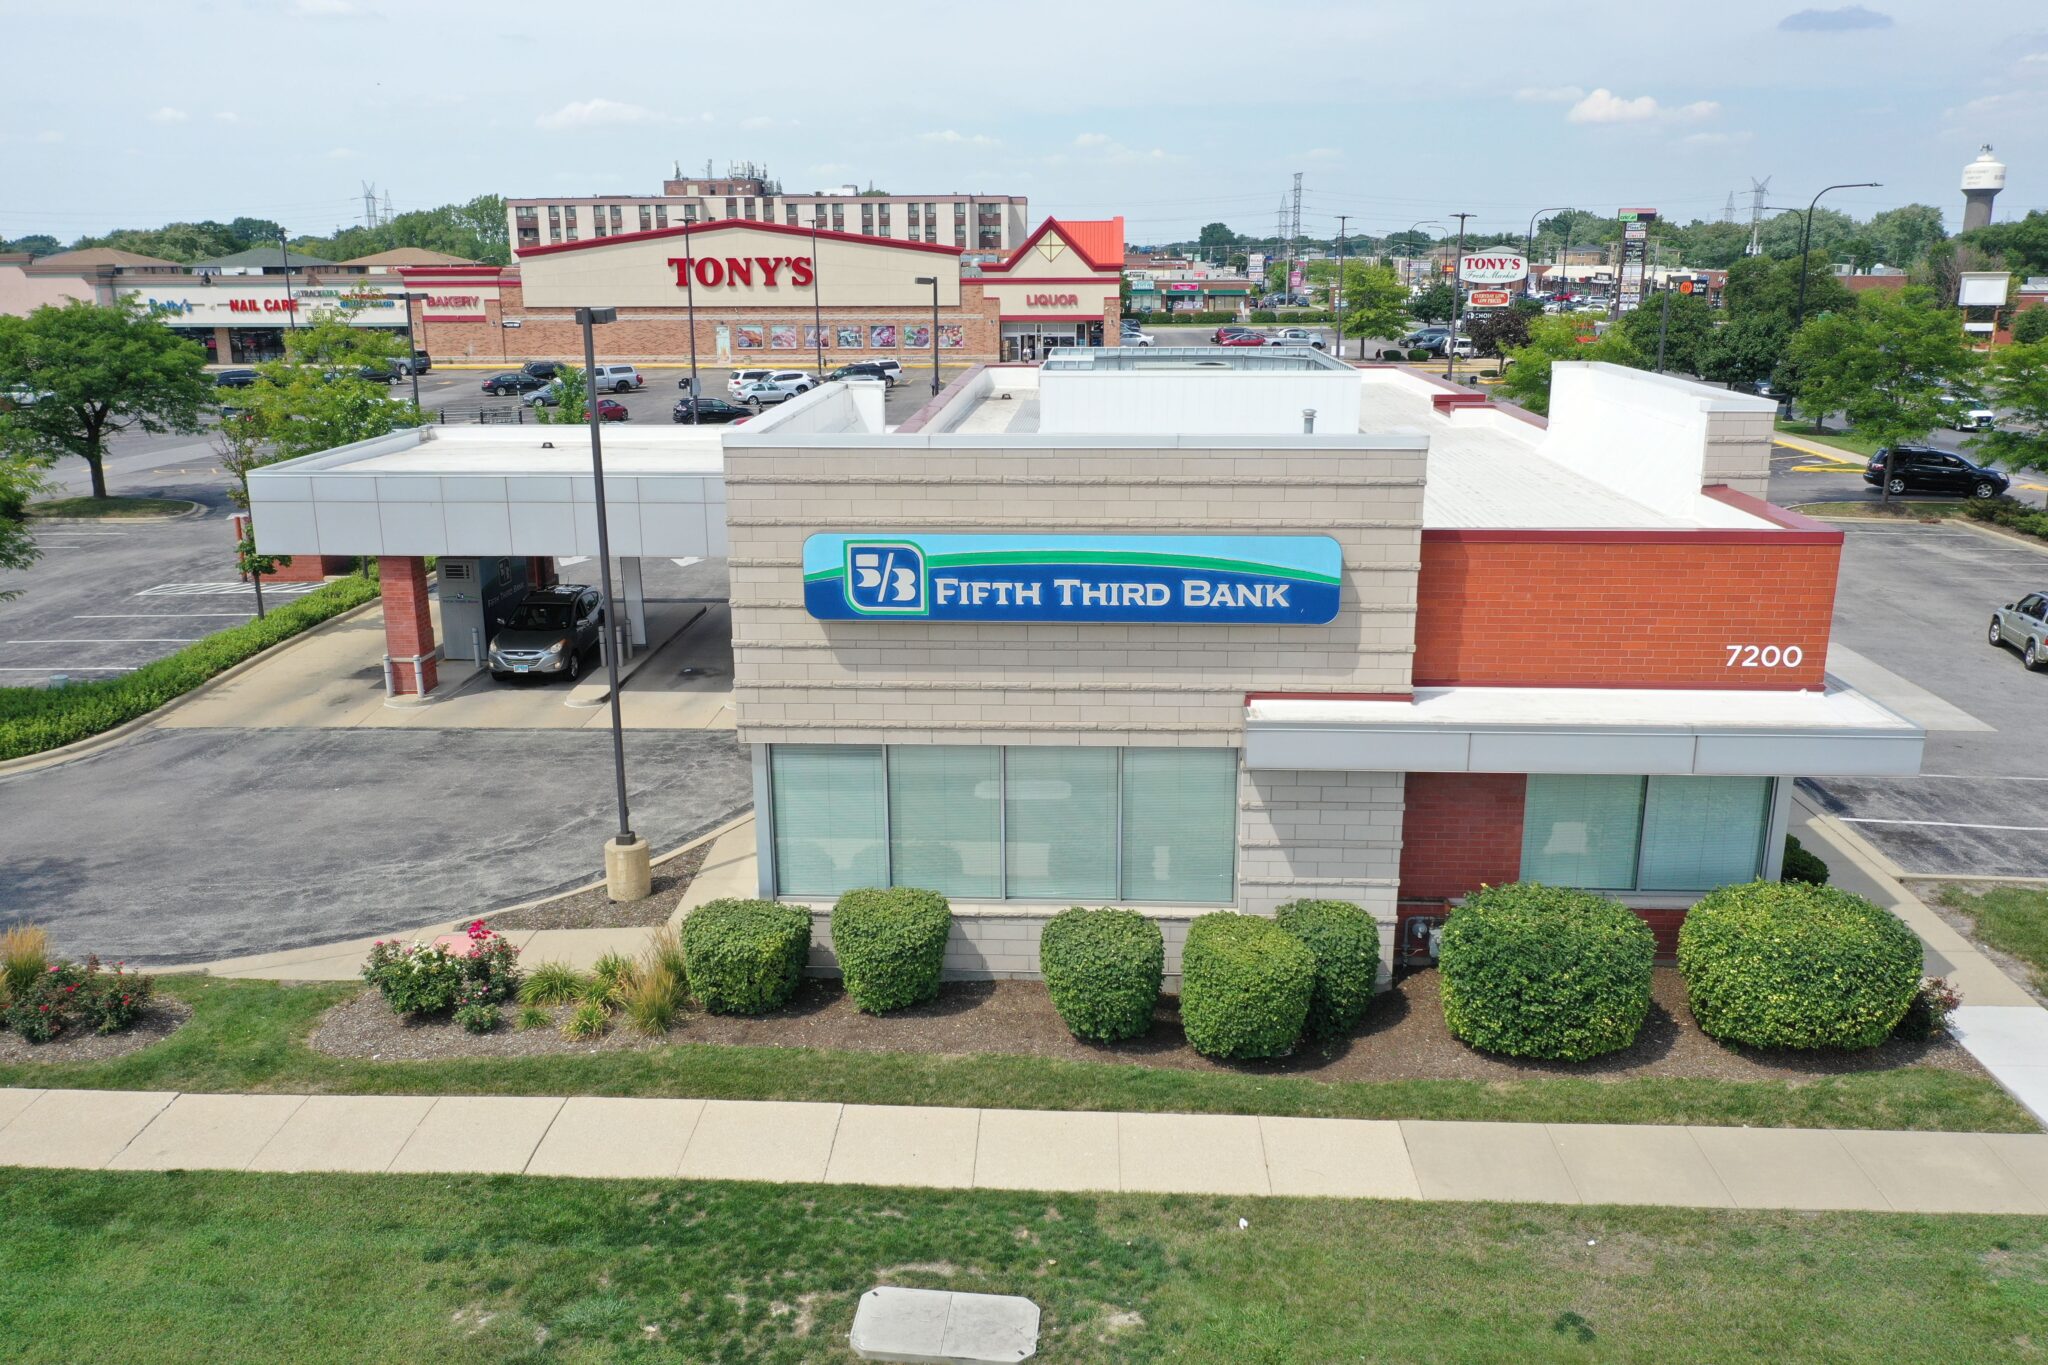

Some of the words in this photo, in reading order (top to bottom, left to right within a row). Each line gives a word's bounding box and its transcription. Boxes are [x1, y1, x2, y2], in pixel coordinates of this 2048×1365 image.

[1465, 258, 1520, 270] TONY'S
[668, 257, 814, 287] TONY'S
[1465, 271, 1486, 279] Fresh
[1487, 270, 1517, 279] Market
[229, 299, 260, 312] NAIL
[264, 298, 299, 312] CARE
[427, 296, 479, 307] BAKERY
[1026, 294, 1079, 306] LIQUOR
[934, 578, 1042, 605] FIFTH
[1053, 578, 1171, 606] THIRD
[1183, 579, 1290, 608] BANK
[1726, 645, 1803, 668] 7200
